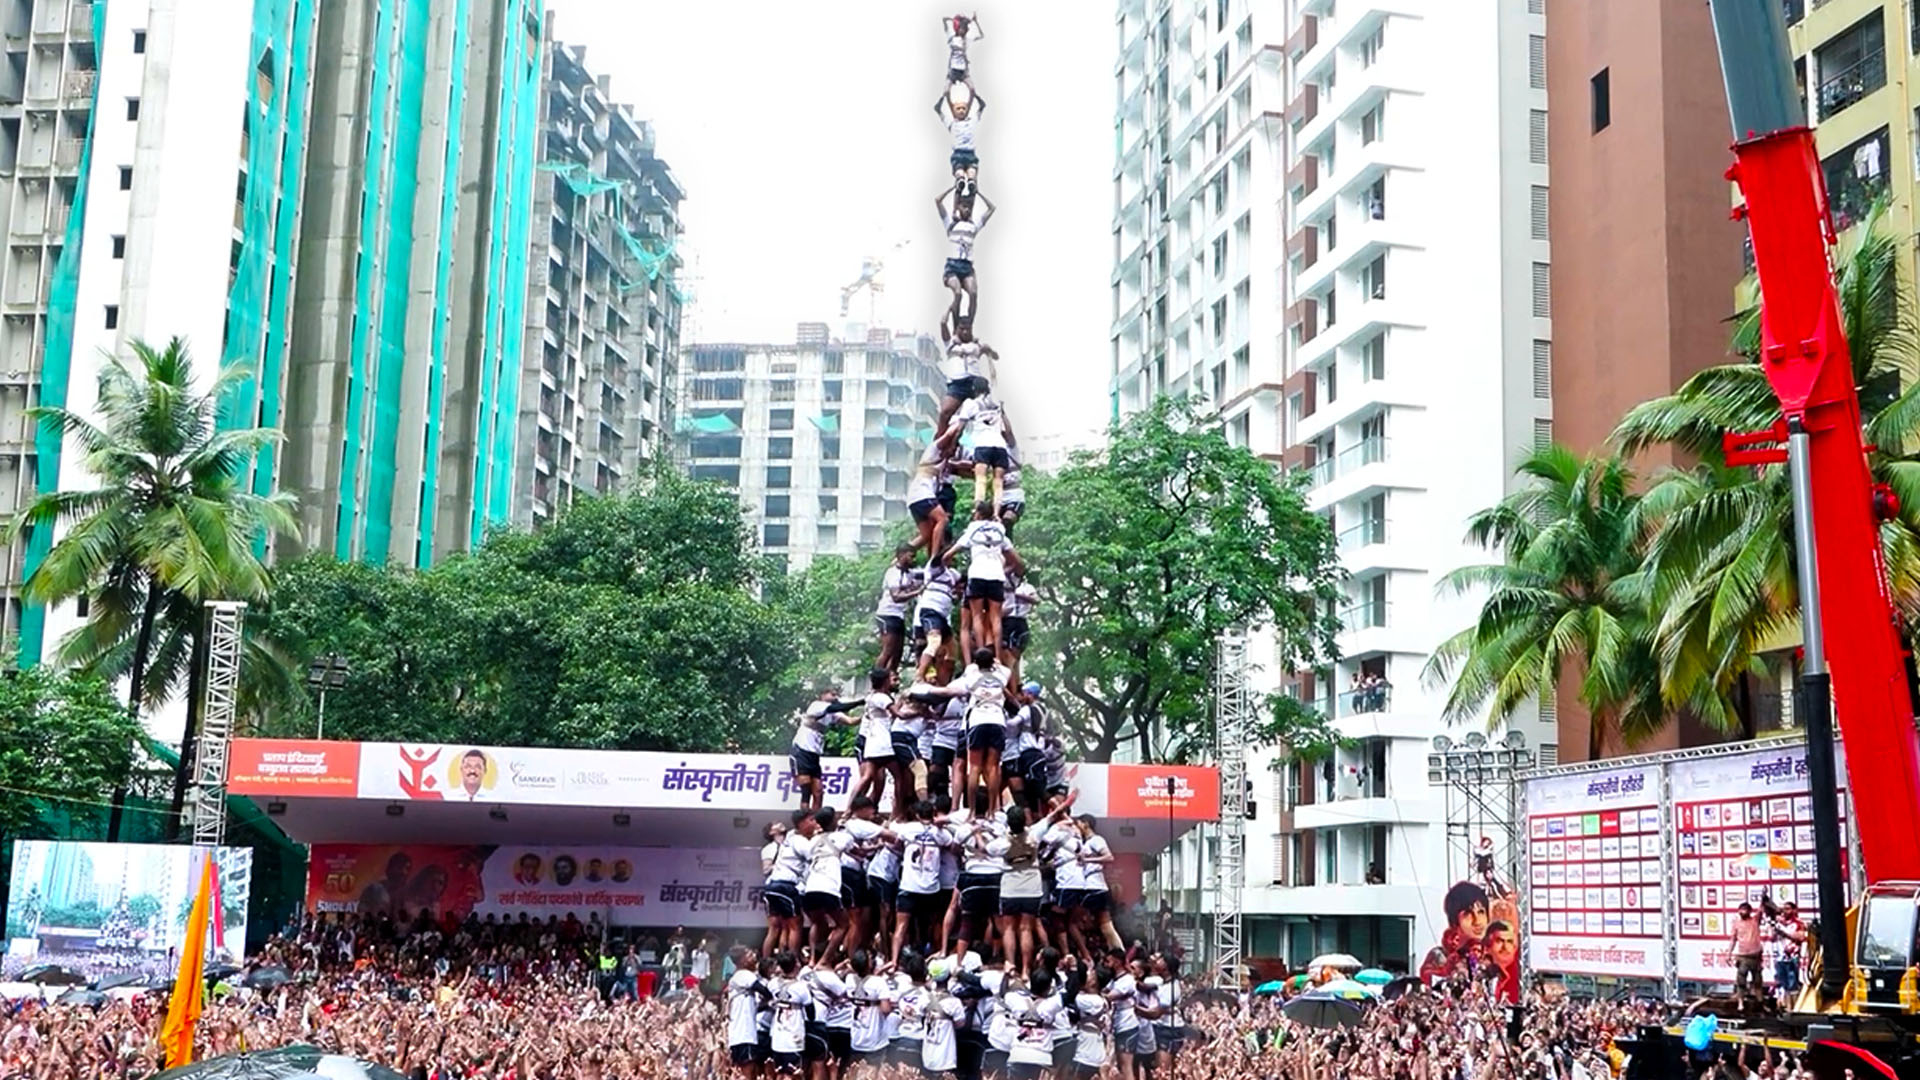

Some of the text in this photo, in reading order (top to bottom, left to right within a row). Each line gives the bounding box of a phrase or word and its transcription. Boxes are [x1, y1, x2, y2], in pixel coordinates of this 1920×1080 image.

[662, 762, 770, 802] संस्कृतीची
[1751, 756, 1793, 785] संस्कृतीची
[326, 872, 356, 893] 50
[659, 880, 744, 911] संस्कृतीची
